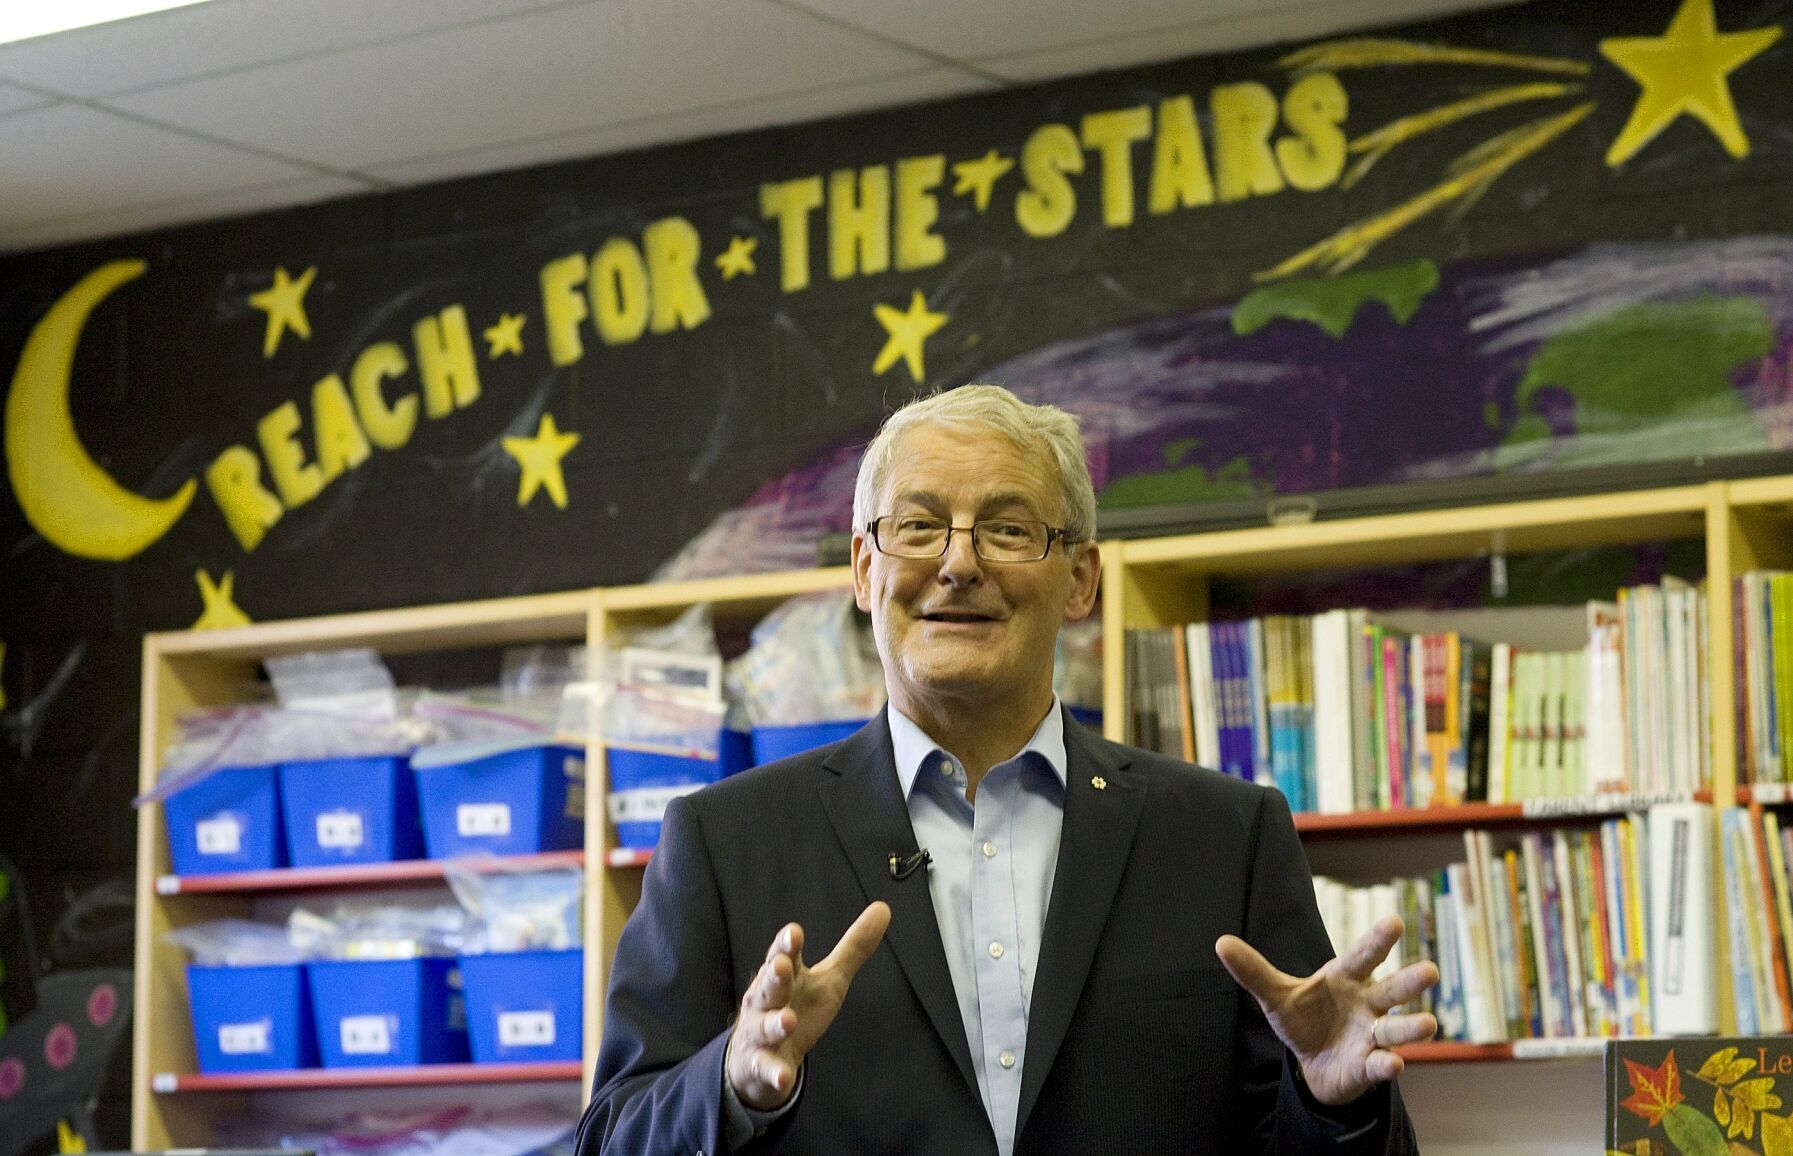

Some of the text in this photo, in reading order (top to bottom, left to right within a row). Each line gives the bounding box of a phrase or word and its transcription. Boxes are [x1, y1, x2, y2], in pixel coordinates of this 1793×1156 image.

[207, 74, 1350, 551] REACH FOR THE STARS
